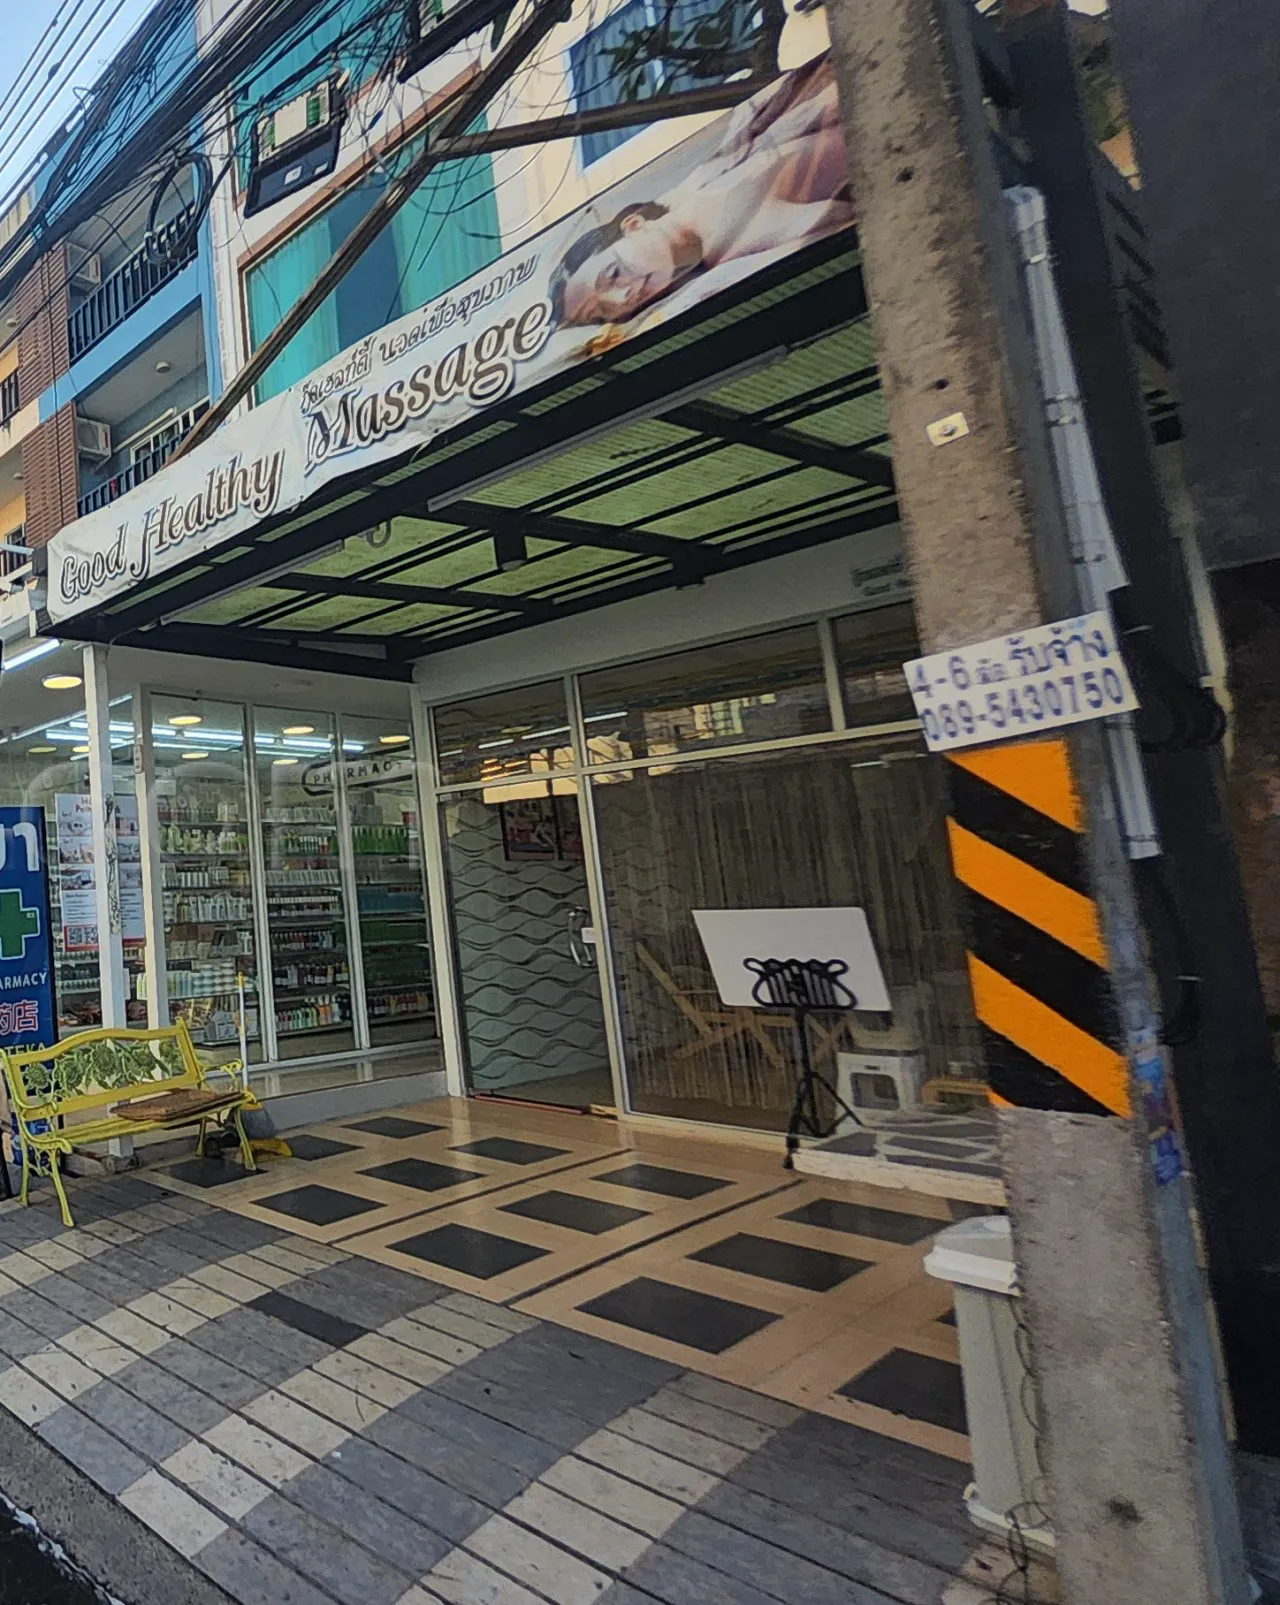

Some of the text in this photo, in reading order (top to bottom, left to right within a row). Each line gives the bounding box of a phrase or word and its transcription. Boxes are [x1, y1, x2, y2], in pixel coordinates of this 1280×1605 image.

[60, 301, 550, 602] Good Healthy Massage
[913, 655, 972, 698] 4-6
[920, 666, 1126, 742] 089-5430750
